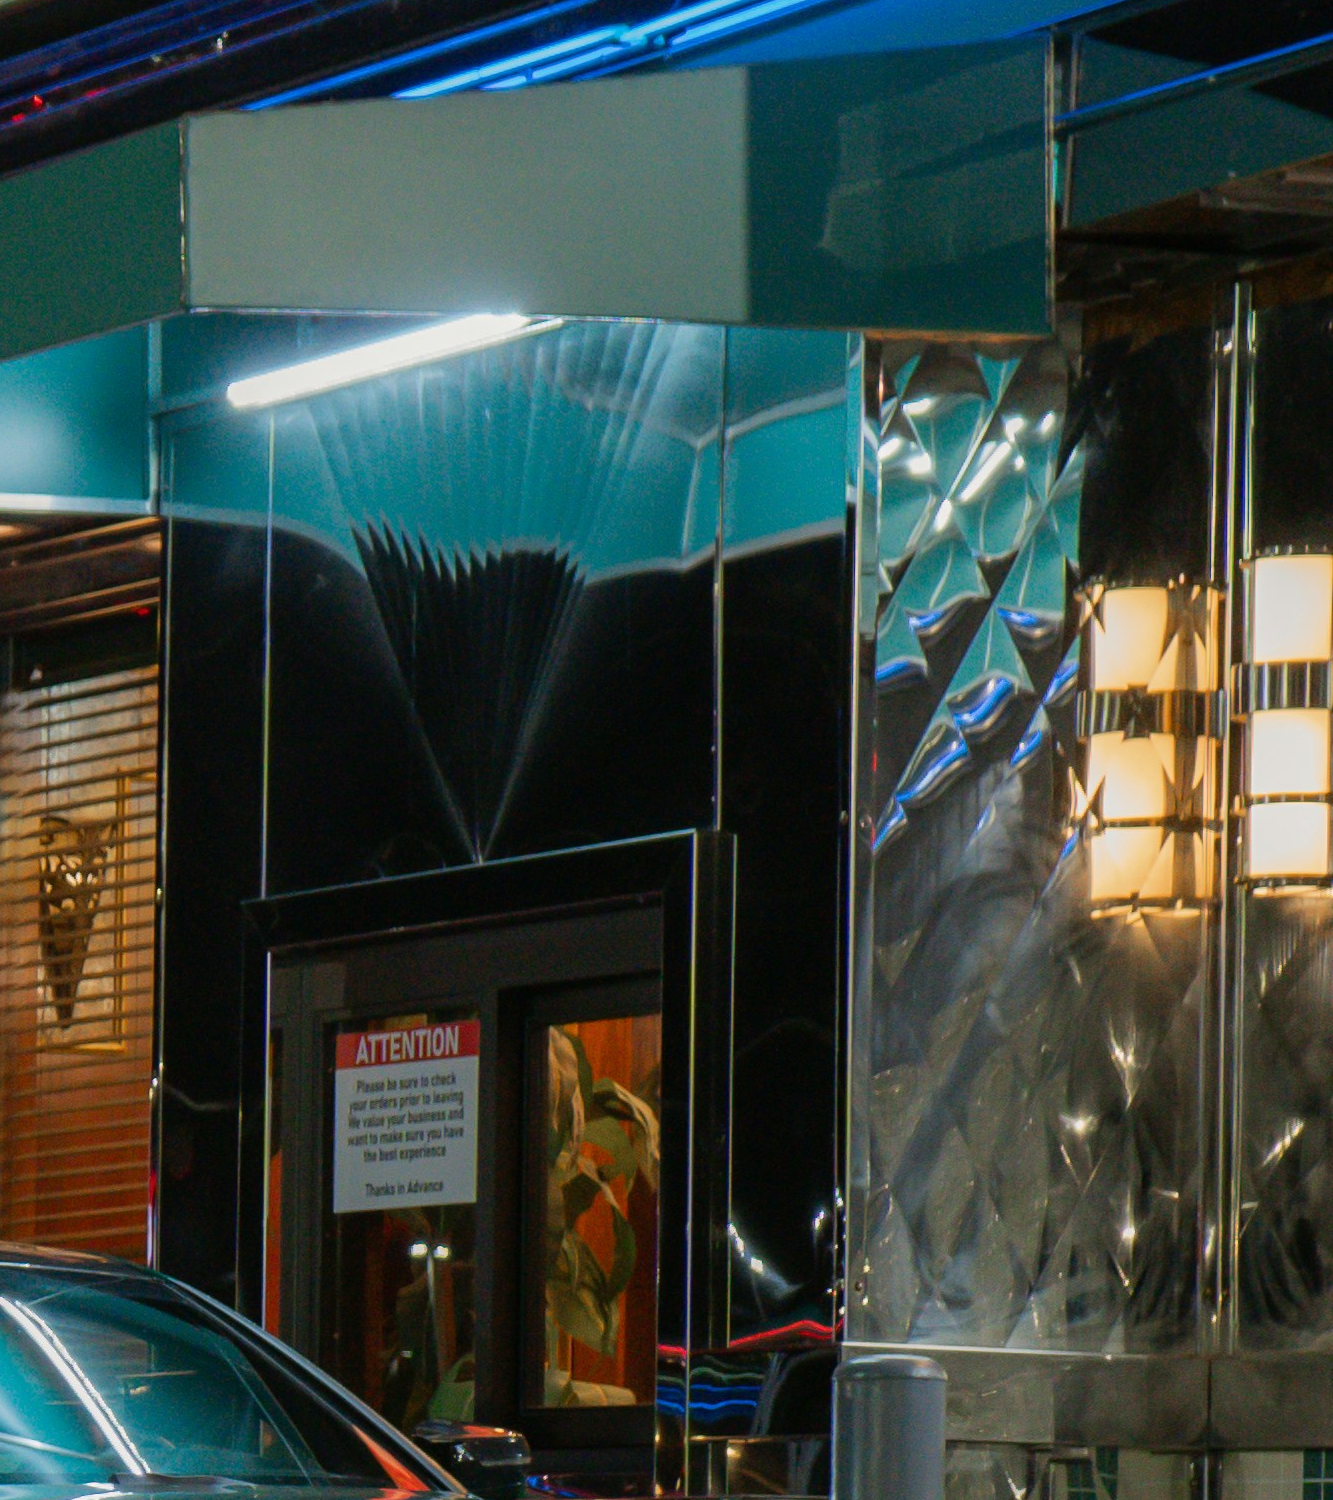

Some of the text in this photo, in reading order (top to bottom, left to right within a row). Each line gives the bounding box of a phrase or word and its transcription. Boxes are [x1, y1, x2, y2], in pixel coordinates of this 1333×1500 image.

[355, 1025, 460, 1065] ATTENTION
[356, 1072, 457, 1093] Please be sure to check
[349, 1090, 464, 1116] your orders prior to leaving
[363, 1113, 385, 1127] value
[387, 1113, 406, 1129] your
[407, 1109, 446, 1124] business
[449, 1107, 464, 1120] and
[348, 1124, 464, 1146] want to make sure you have
[364, 1145, 446, 1163] the best experience
[365, 1180, 443, 1198] Thanks in Advance
